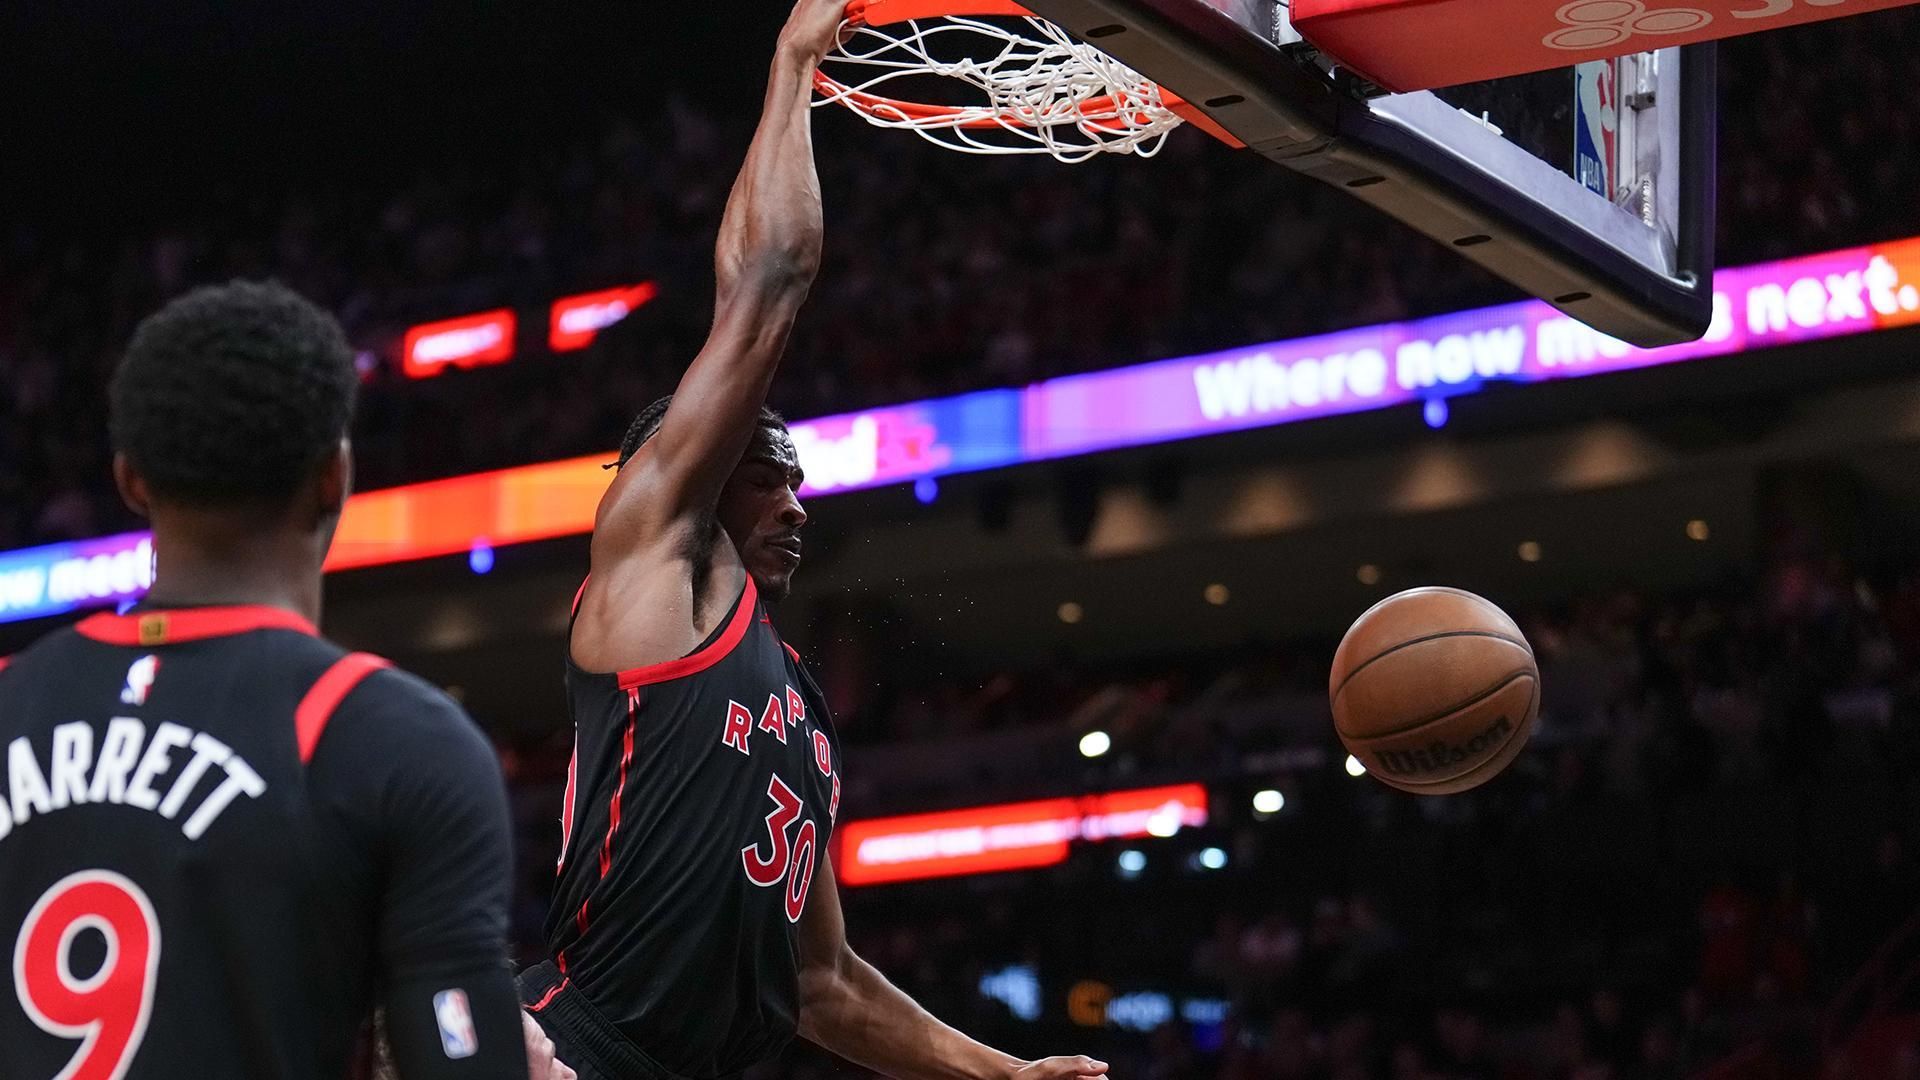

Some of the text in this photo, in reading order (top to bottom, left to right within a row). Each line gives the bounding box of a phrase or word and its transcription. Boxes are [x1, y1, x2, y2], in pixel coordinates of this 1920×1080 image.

[1580, 152, 1600, 191] NBA
[1193, 352, 1388, 420] Where
[1395, 325, 1526, 389] now
[1746, 255, 1918, 334] next.
[0, 716, 267, 841] ARRETT
[722, 684, 841, 828] RAPOR
[1371, 713, 1512, 775] Wilson
[741, 772, 816, 923] 30
[13, 868, 162, 1080] 9
